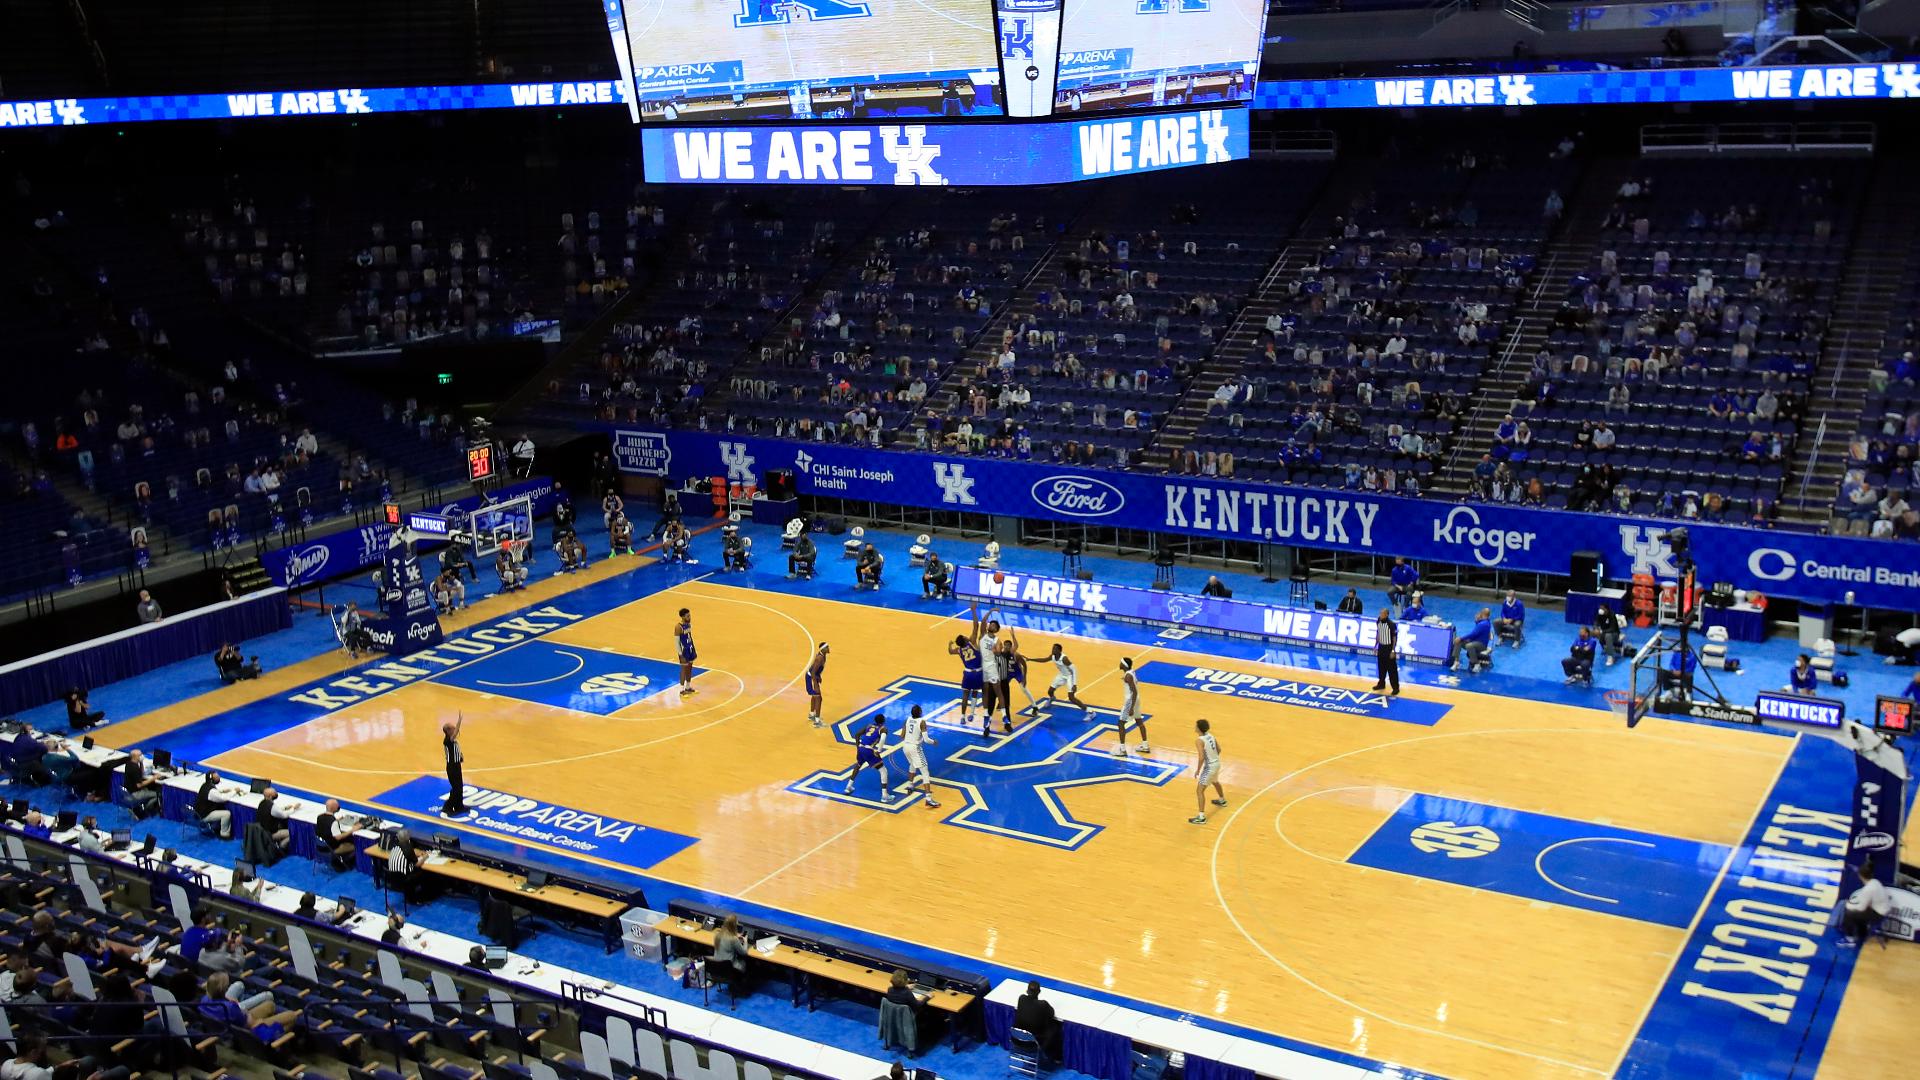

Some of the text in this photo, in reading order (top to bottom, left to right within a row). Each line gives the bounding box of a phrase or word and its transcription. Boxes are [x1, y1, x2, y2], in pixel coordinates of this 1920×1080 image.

[511, 85, 554, 106] WE
[560, 82, 612, 104] ARE
[1375, 80, 1424, 105] WE
[1430, 78, 1495, 104] ARE
[1732, 70, 1792, 98] WE
[1798, 68, 1877, 97] ARE
[0, 102, 53, 126] ARE
[228, 94, 275, 116] WE
[280, 92, 336, 114] ARE
[673, 132, 754, 179] WE
[766, 131, 873, 179] ARE
[1079, 122, 1132, 175] WE
[1138, 117, 1196, 168] ARE
[472, 458, 488, 478] 30
[812, 463, 894, 484] CHI Saint Joseph
[814, 476, 847, 490] Health
[1048, 480, 1107, 512] Ford
[411, 517, 446, 532] KENTUCKY
[1165, 485, 1380, 547] KENTUCKY
[1433, 506, 1537, 566] Kroger
[1802, 560, 1871, 583] Central
[979, 572, 1019, 598] WE
[1022, 578, 1076, 606] ARE
[408, 622, 436, 640] Kroger
[1264, 609, 1311, 638] WE
[1315, 616, 1377, 648] ARE
[289, 605, 584, 710] KENTUCKY
[962, 648, 976, 661] 22
[580, 671, 650, 696] SEC
[1185, 667, 1389, 708] RUPP ARENA
[1237, 690, 1285, 702] Central
[1285, 697, 1322, 708] Bank
[1322, 702, 1370, 714] Center
[1759, 698, 1839, 725] KENTUCKY
[475, 817, 598, 851] Central Bank Center
[518, 806, 636, 843] ARENA
[1410, 821, 1500, 858] SEC
[1681, 803, 1853, 1026] KENTUCKY
